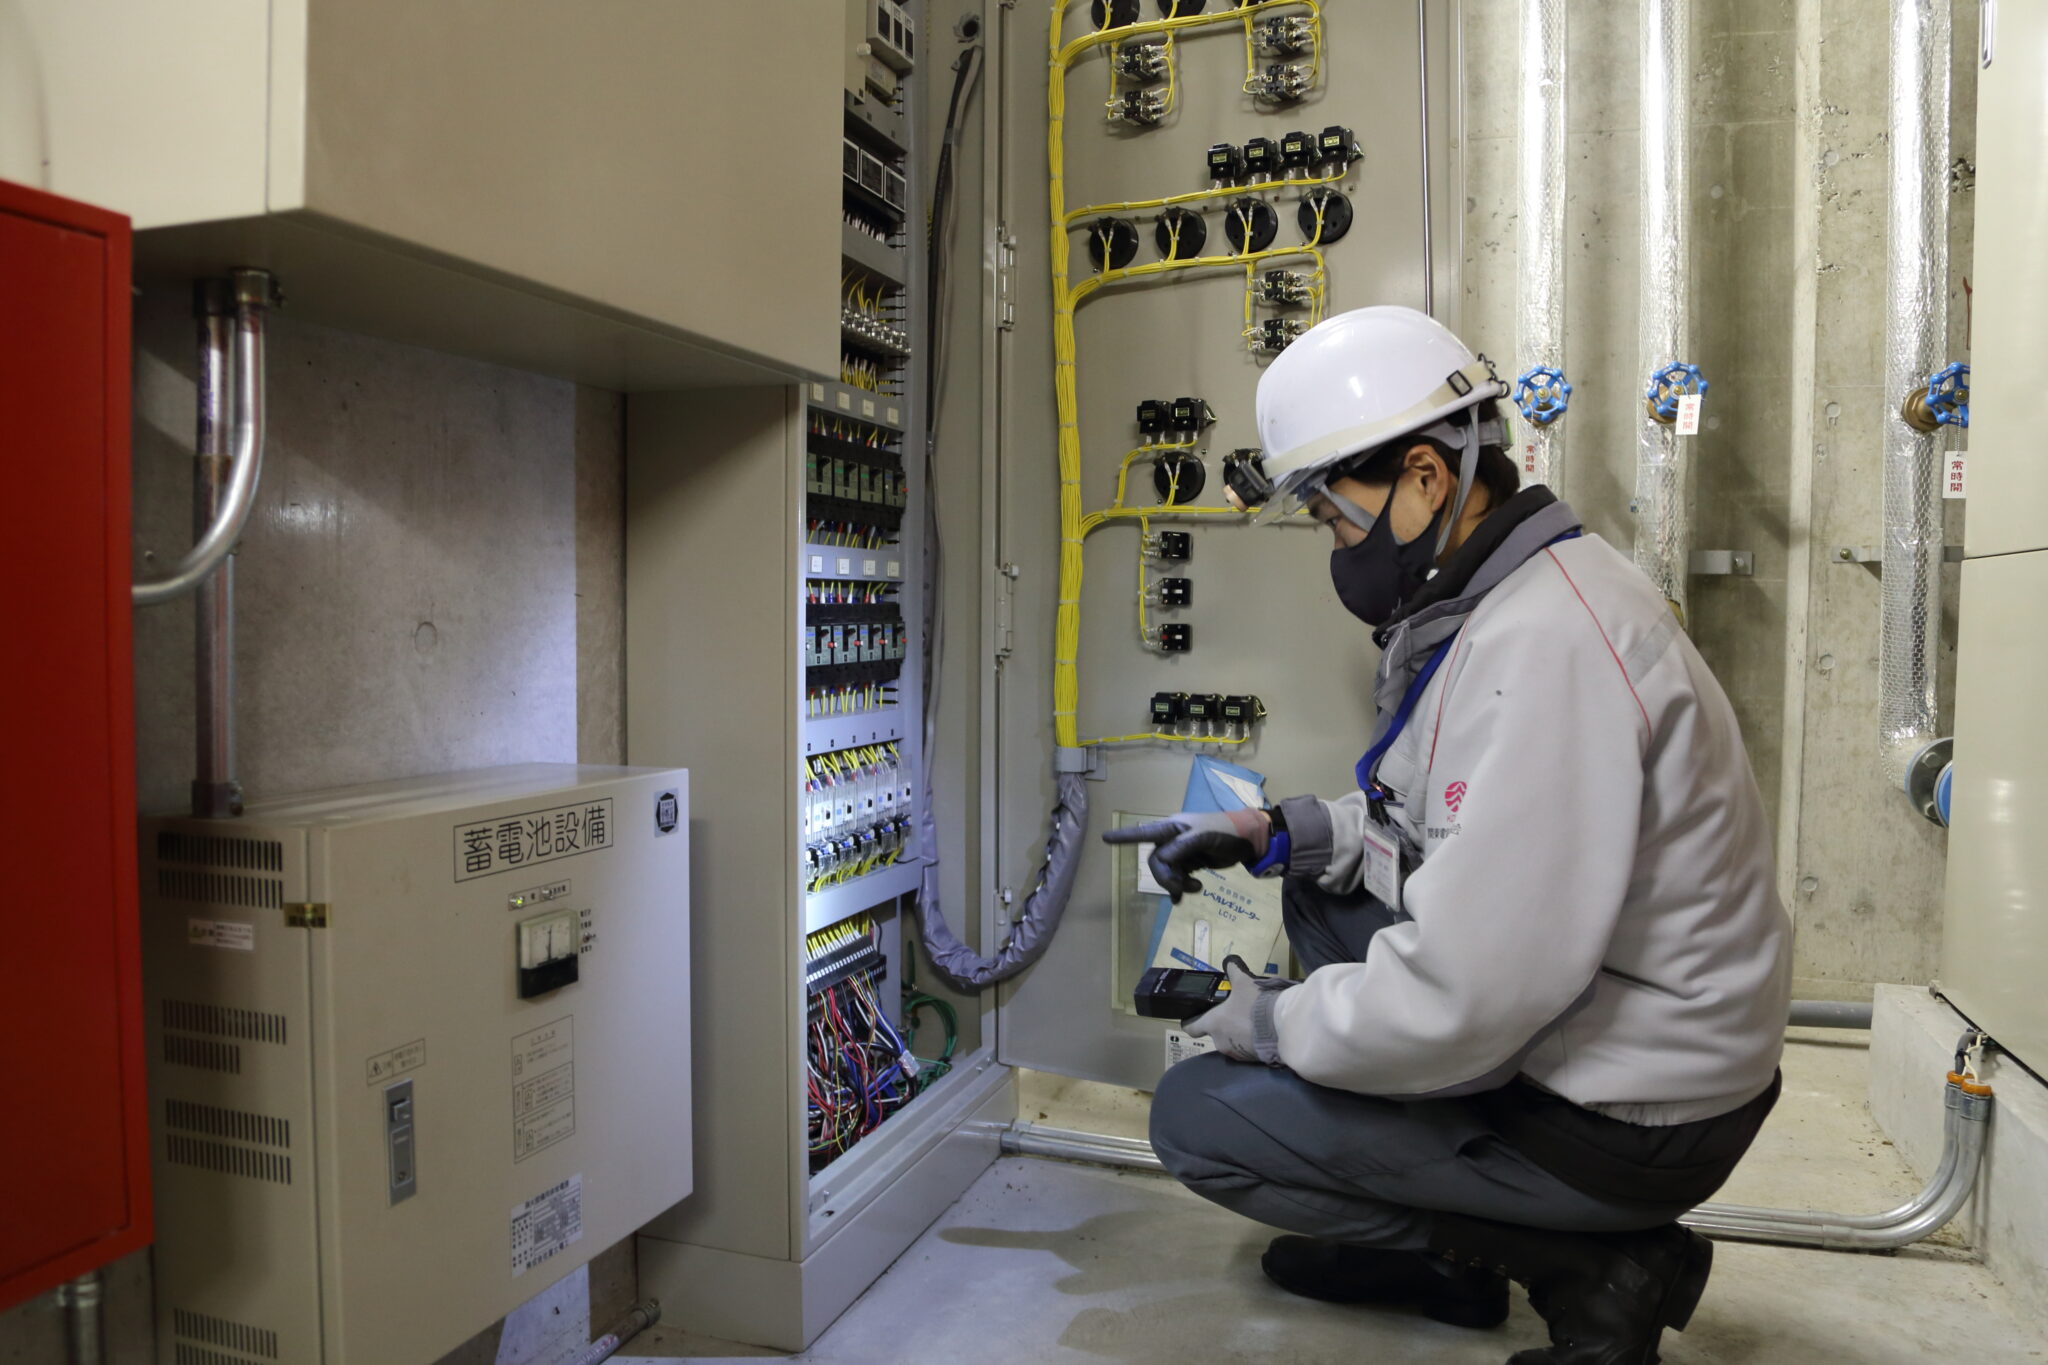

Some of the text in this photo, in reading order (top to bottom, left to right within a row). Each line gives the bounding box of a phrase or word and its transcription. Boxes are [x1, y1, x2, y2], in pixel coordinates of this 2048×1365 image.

[463, 804, 606, 874] 蓄電池設備
[1218, 908, 1237, 922] LC12
